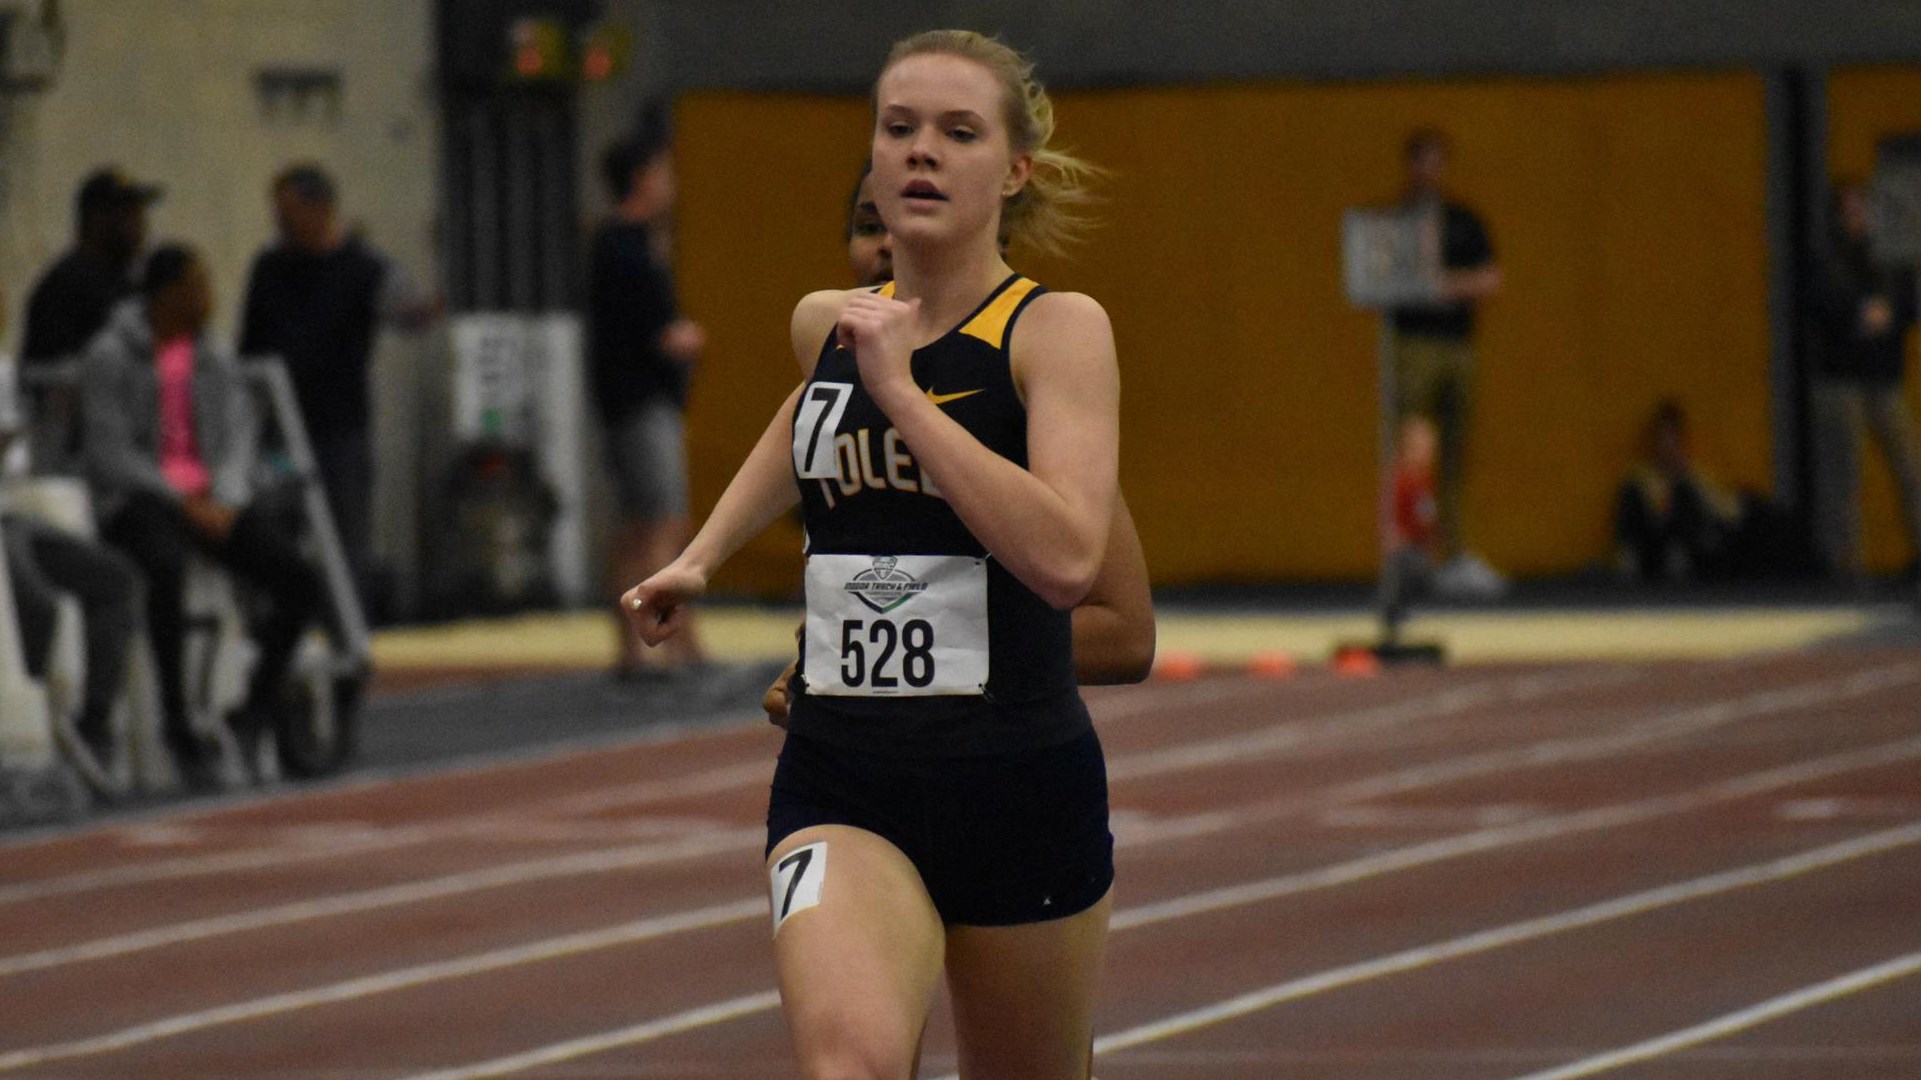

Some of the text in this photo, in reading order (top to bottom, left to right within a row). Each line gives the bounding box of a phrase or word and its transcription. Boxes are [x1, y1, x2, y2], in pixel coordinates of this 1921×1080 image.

[804, 387, 842, 473] 7
[819, 425, 943, 511] OLE
[871, 582, 897, 591] TRACK
[903, 582, 929, 591] FIELD
[841, 619, 935, 688] 528
[778, 847, 813, 921] 7
